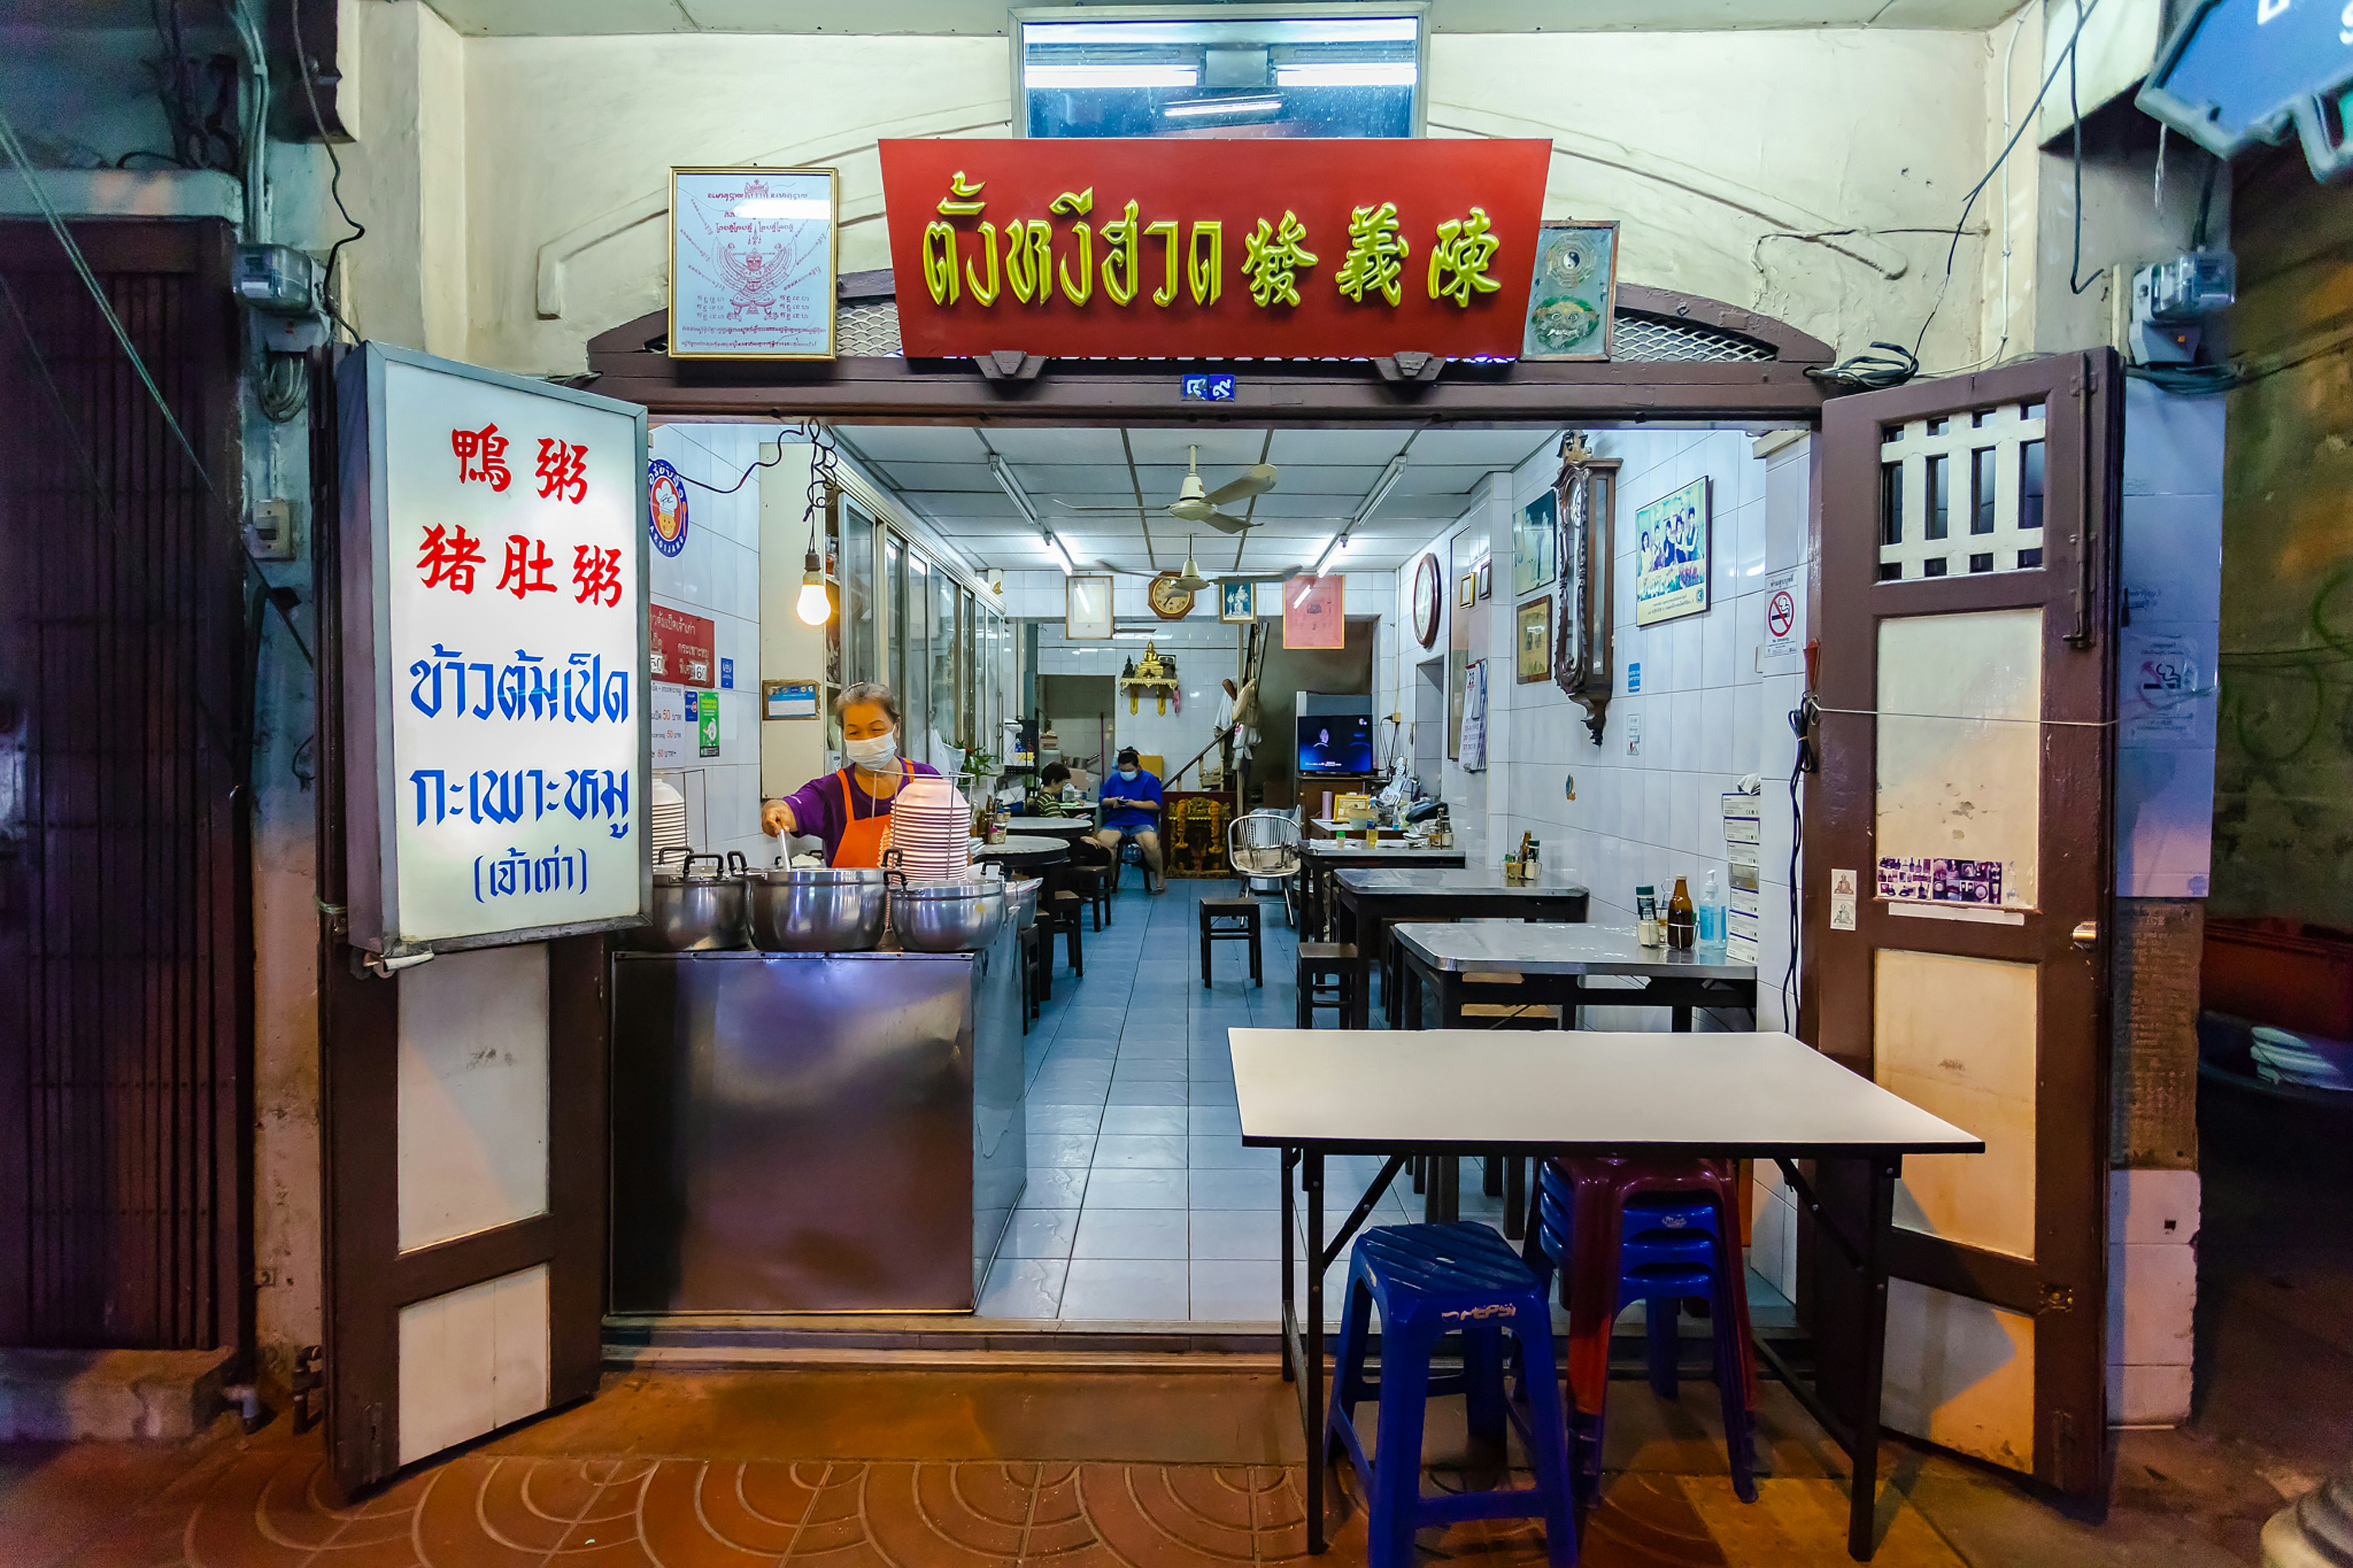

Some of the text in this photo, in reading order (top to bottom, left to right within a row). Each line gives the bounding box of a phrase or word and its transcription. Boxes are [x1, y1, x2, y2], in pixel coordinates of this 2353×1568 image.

[923, 171, 1222, 306] ตั้งหงีฮวด
[452, 423, 588, 505] 鴨粥
[410, 643, 628, 724] ข้าวต้มเป็ด
[662, 709, 671, 721] 50
[410, 769, 628, 838] กะเพาะหมู
[474, 847, 587, 903] (เจ้าเก่า)
